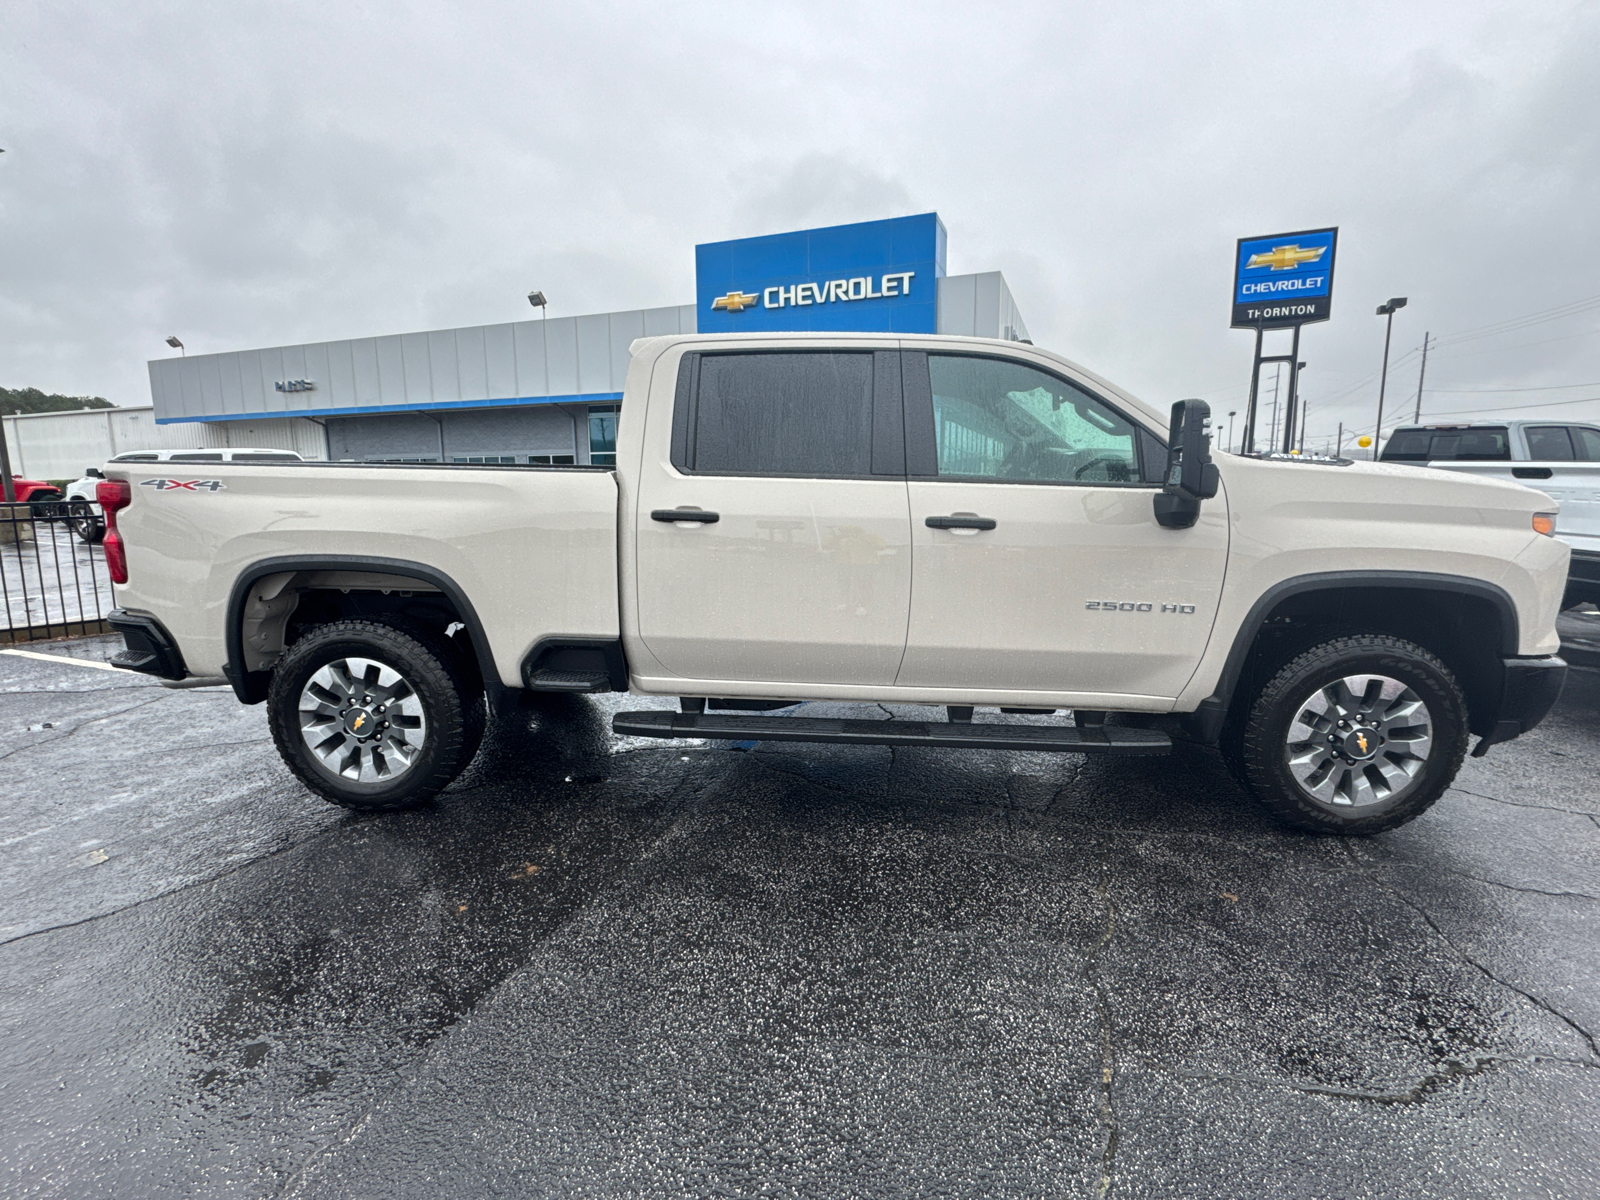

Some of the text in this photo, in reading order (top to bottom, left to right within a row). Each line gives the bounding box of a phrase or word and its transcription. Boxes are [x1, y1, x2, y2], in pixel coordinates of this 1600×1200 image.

[764, 271, 915, 309] CHEVROLET
[1242, 276, 1324, 295] CHEVROLET
[1247, 304, 1316, 319] THORNTON
[1085, 600, 1195, 614] 2500 HD
